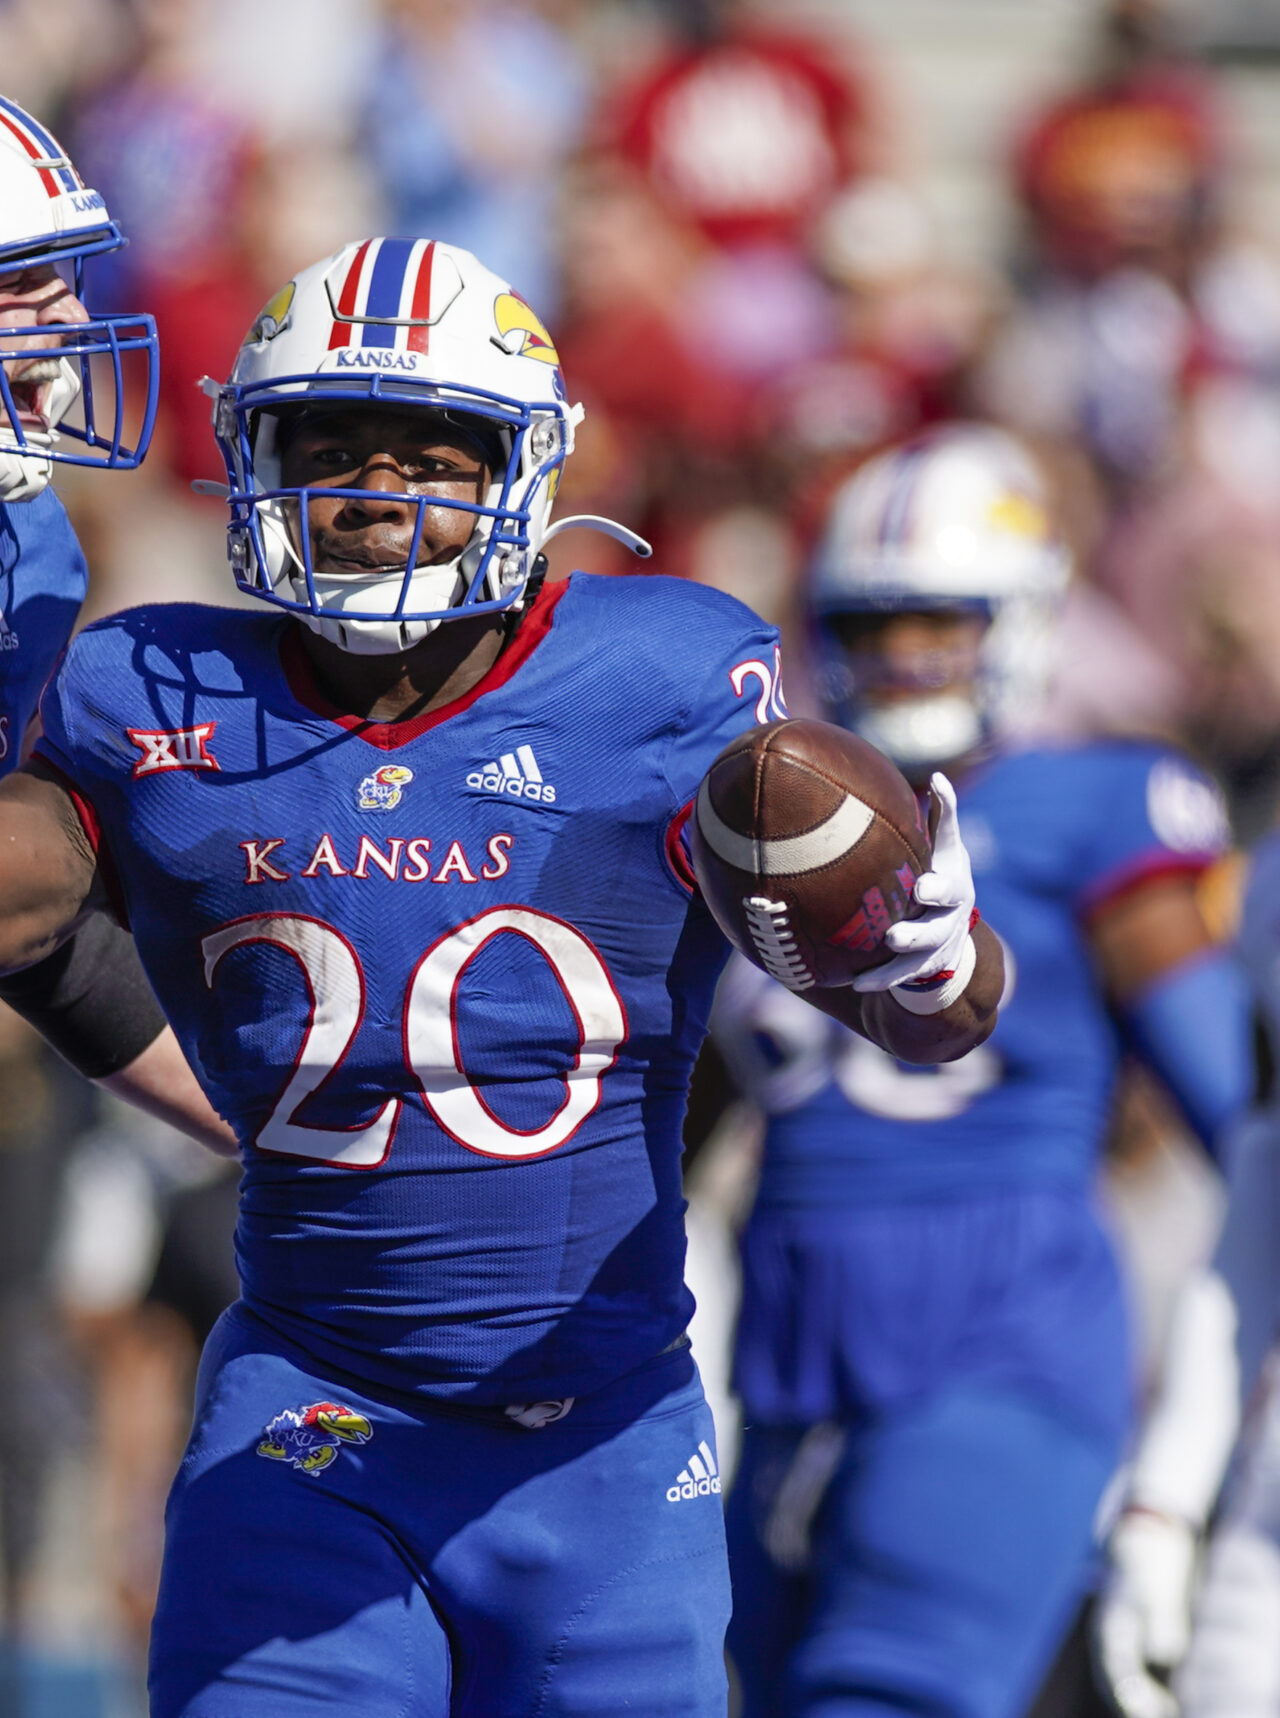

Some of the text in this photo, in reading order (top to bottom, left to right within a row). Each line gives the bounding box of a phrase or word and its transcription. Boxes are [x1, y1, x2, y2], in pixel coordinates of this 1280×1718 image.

[336, 350, 417, 371] KANSAS
[465, 772, 557, 804] adidas
[238, 832, 515, 884] KANSAS
[200, 904, 630, 1171] 20
